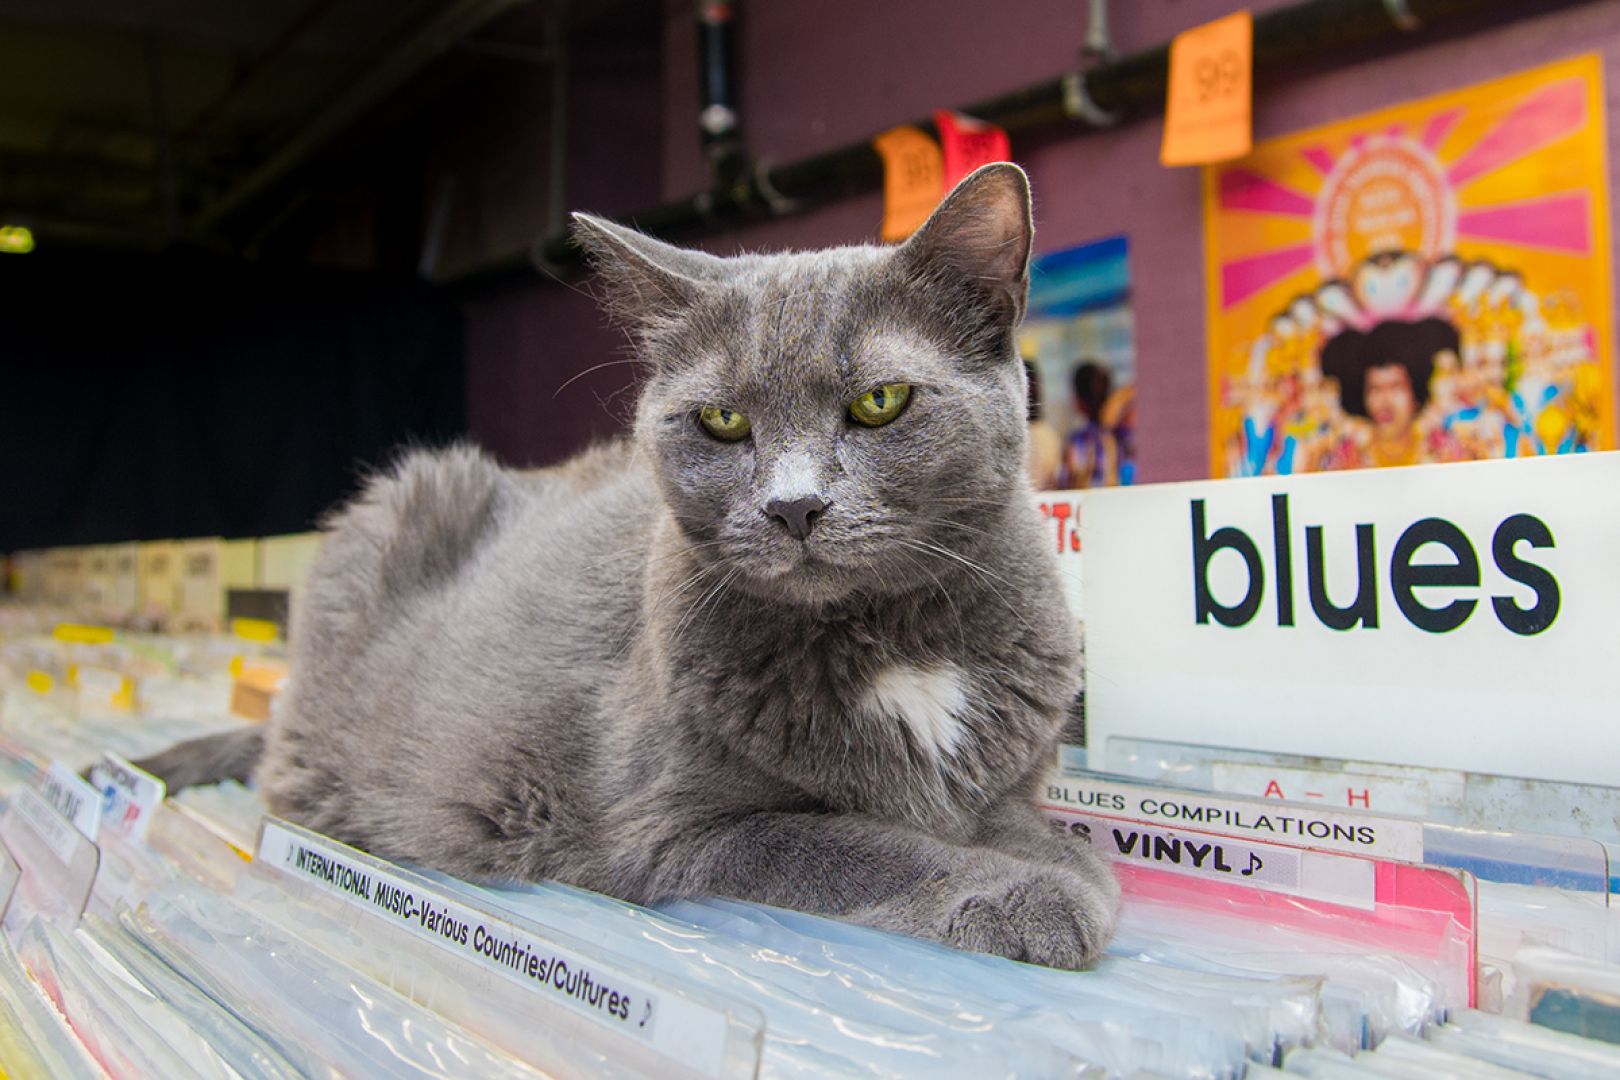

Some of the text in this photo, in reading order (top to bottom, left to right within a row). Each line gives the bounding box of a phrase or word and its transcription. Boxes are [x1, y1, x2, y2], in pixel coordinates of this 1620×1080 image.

[1190, 493, 1562, 636] blues
[1046, 784, 1376, 845] BLUES COMPILATIONS
[1264, 779, 1285, 800] A
[1347, 788, 1370, 808] H
[1112, 828, 1232, 873] VINYL
[295, 850, 631, 1021] INTERNATIONAL MUSIC-Various Countries/Cultures
